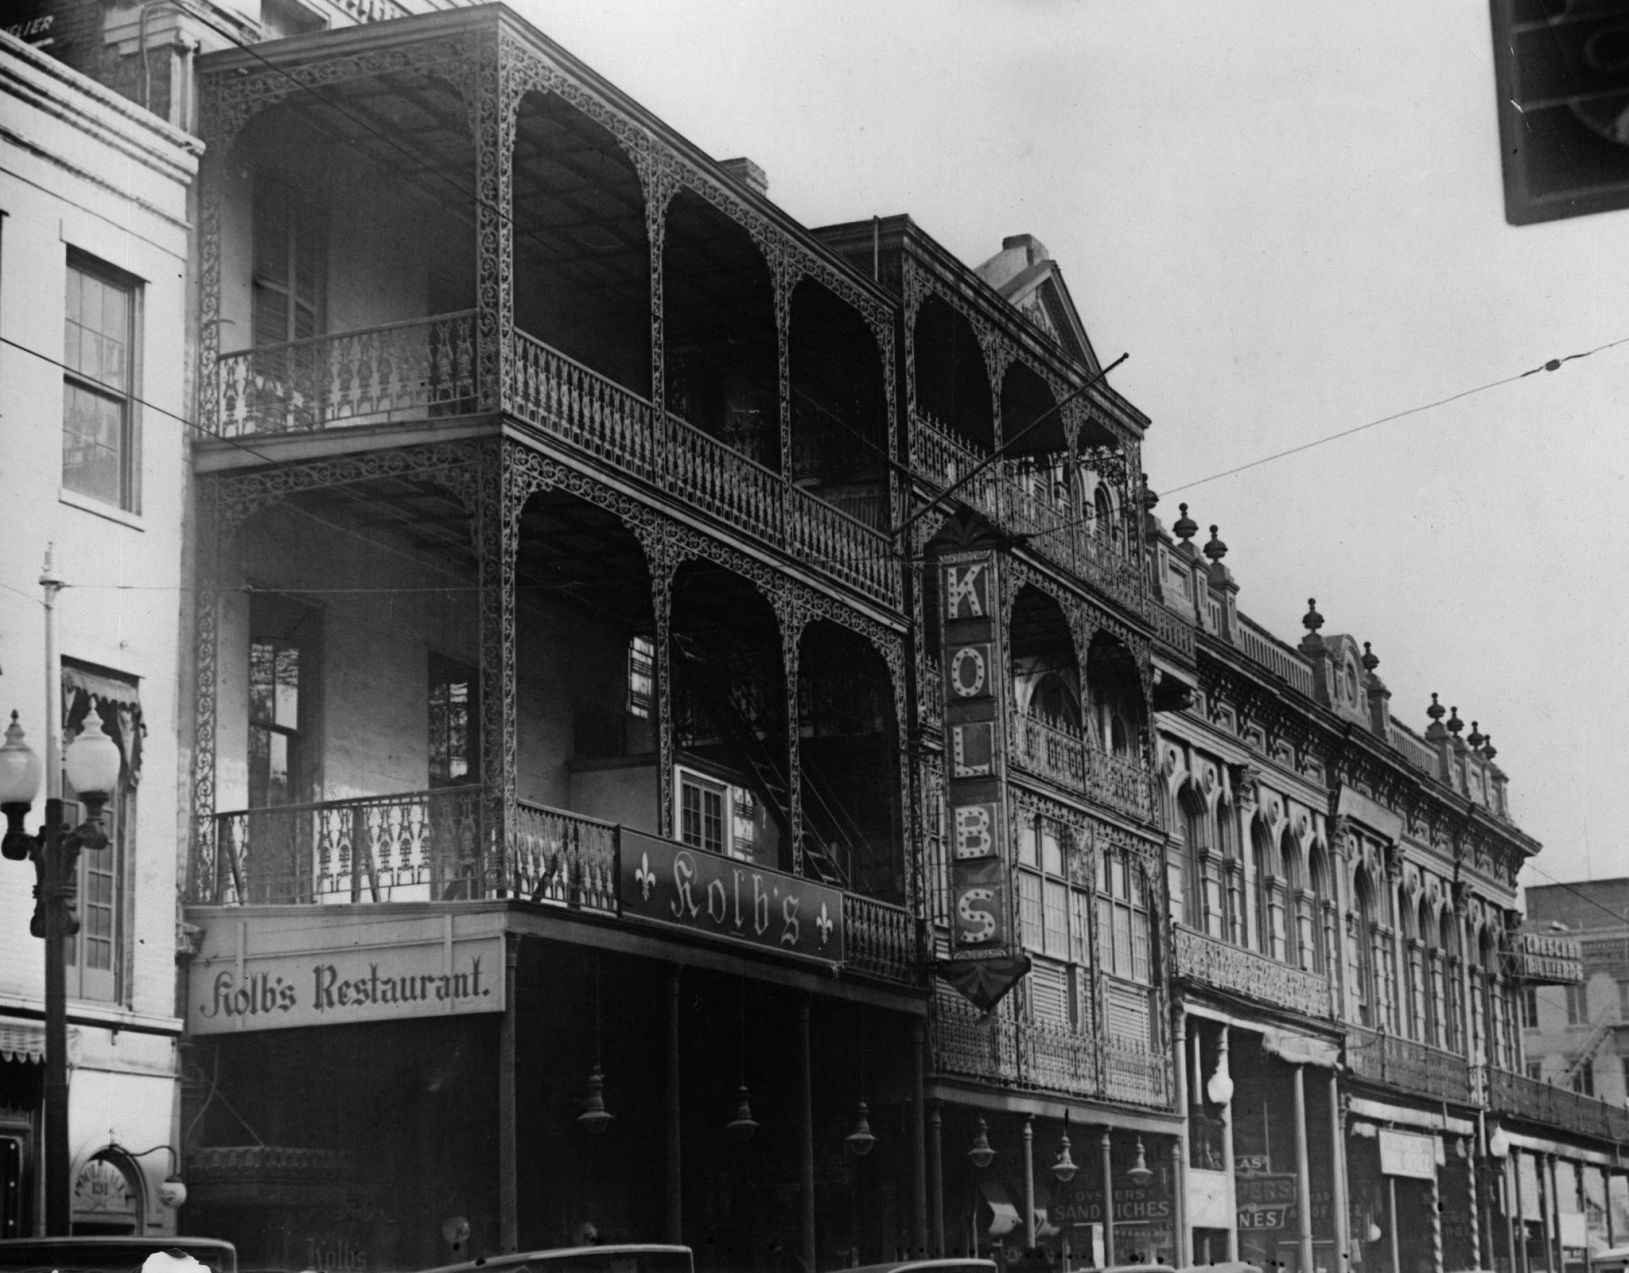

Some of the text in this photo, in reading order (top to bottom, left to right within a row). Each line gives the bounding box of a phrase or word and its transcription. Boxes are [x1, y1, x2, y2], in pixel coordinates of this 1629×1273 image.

[947, 565, 996, 943] KOLBS
[670, 850, 800, 946] Kolb's
[199, 970, 297, 1018] Kolb's
[1055, 1201, 1170, 1221] SANDICHES
[1076, 1189, 1145, 1203] OYSERS
